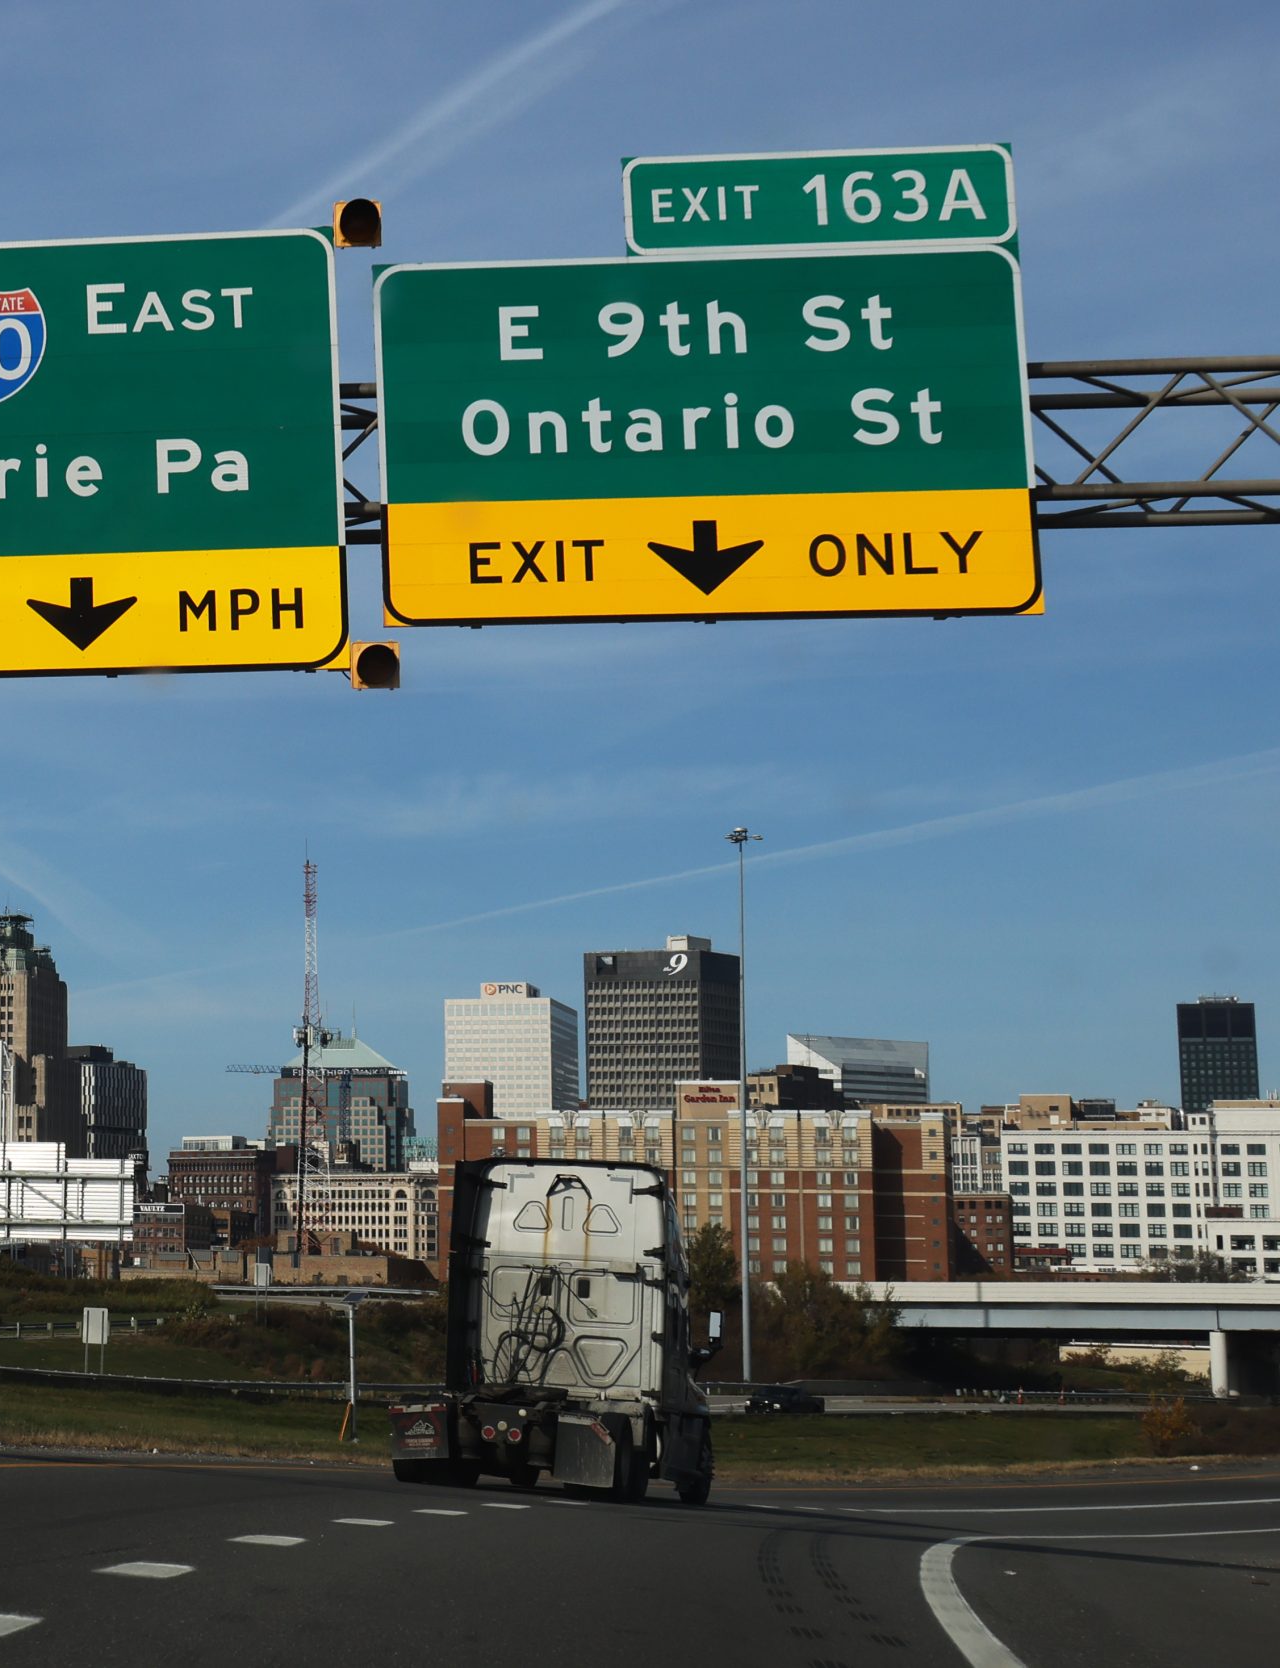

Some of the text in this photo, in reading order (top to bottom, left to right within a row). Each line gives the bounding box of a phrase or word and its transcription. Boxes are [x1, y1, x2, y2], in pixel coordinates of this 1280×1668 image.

[651, 168, 987, 226] EXIT 163A
[86, 282, 254, 335] EAST
[498, 294, 894, 361] E 9th St
[461, 387, 944, 456] Ontario St
[156, 438, 250, 495] Pa
[469, 530, 984, 584] EXIT ONLY
[178, 587, 305, 632] MPH
[497, 984, 523, 994] PNC
[668, 953, 688, 975] 9
